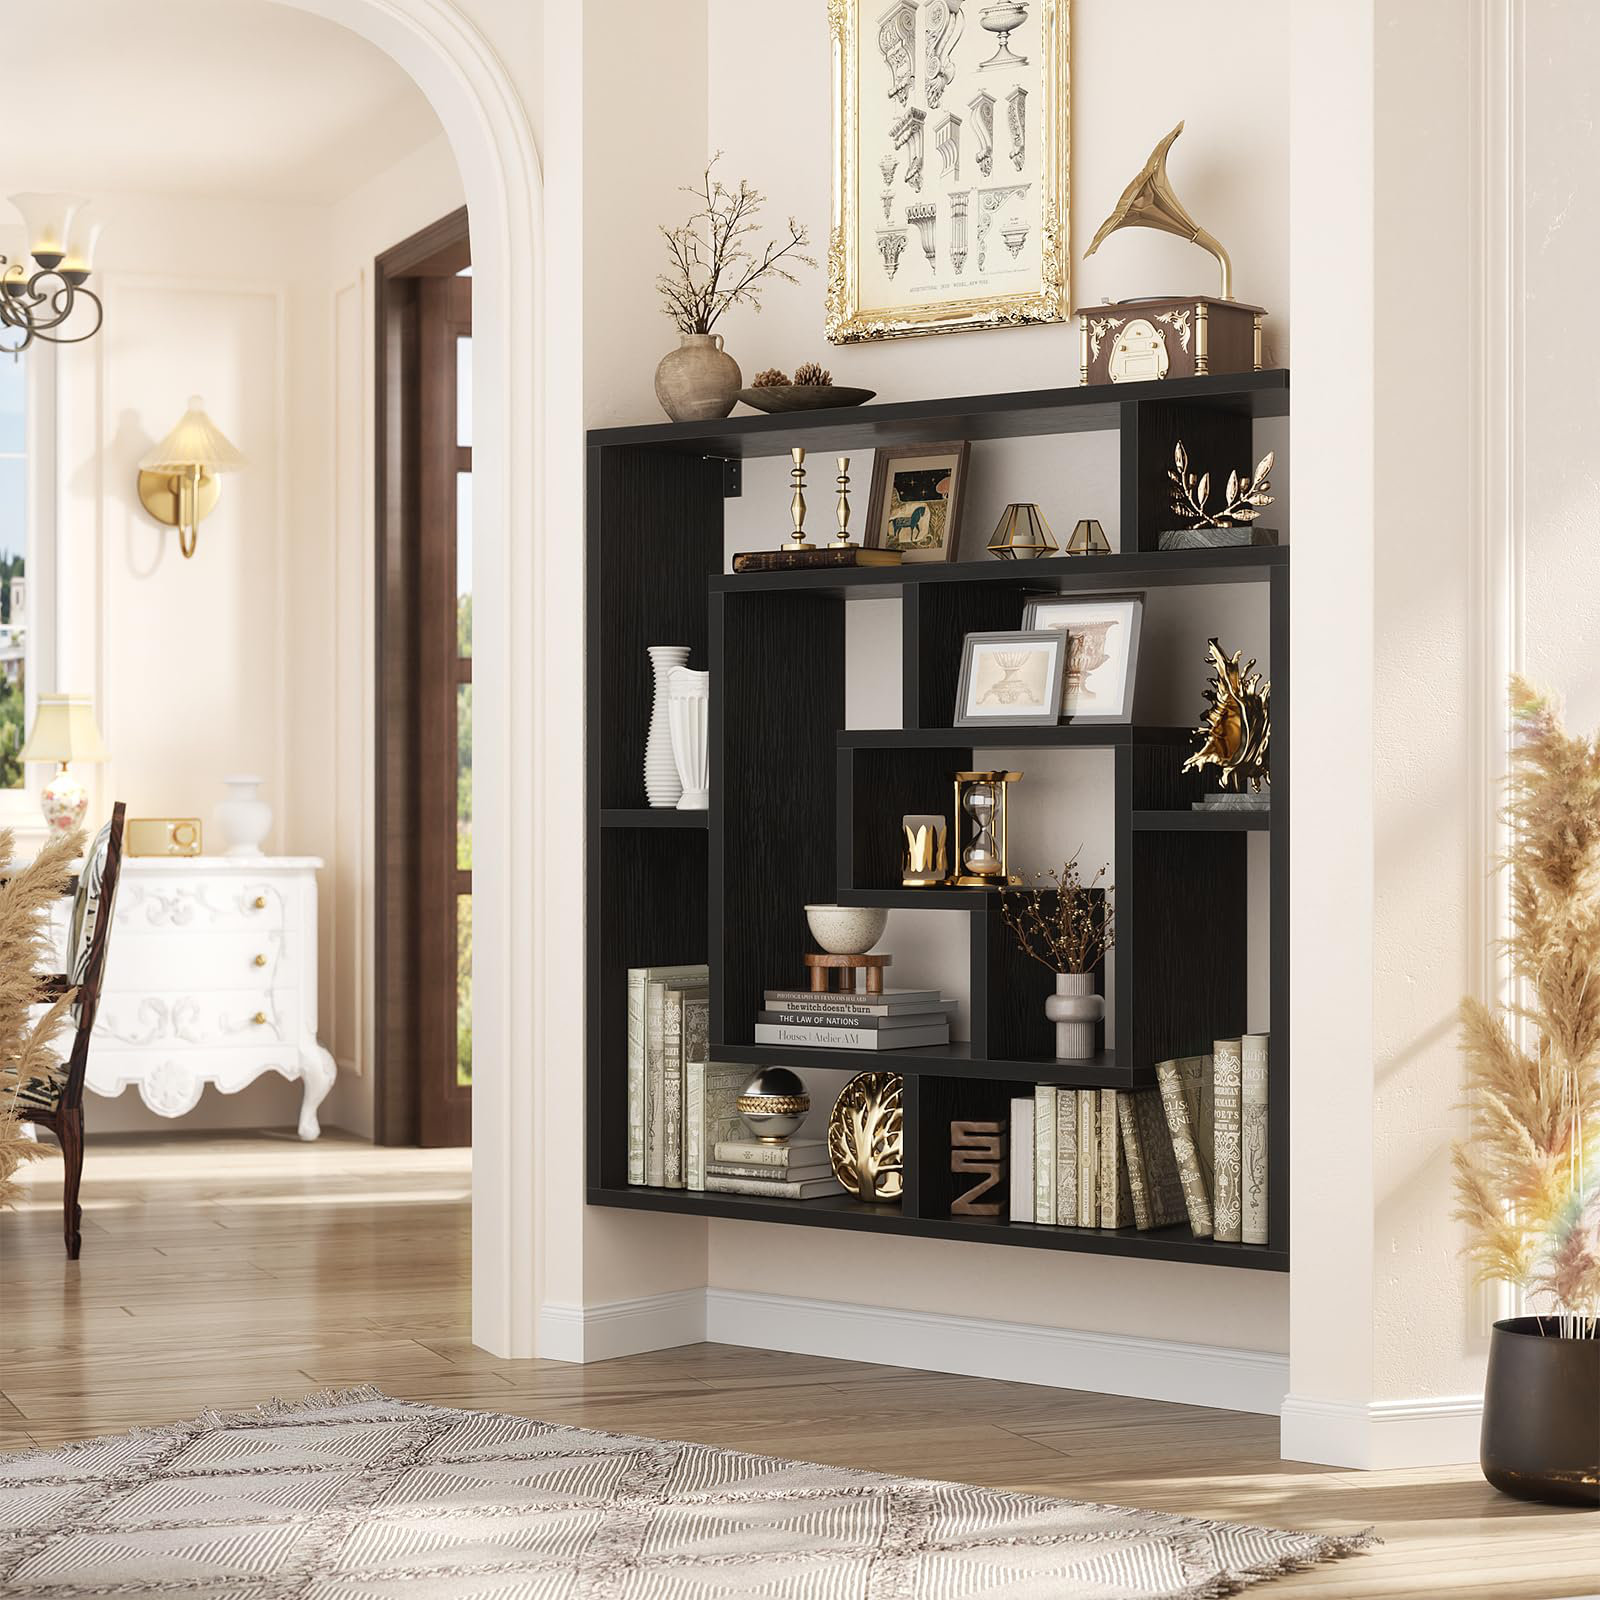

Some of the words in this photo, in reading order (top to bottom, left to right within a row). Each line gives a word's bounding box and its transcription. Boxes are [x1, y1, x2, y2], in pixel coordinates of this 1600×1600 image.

[787, 1002, 799, 1010] the
[800, 1002, 821, 1011] witch
[822, 1003, 852, 1012] doesn't
[852, 1005, 871, 1013] burn
[779, 1015, 794, 1023] THE
[826, 1017, 859, 1025] NATIONS
[777, 1030, 807, 1041] Houses
[815, 1032, 841, 1043] Atelier
